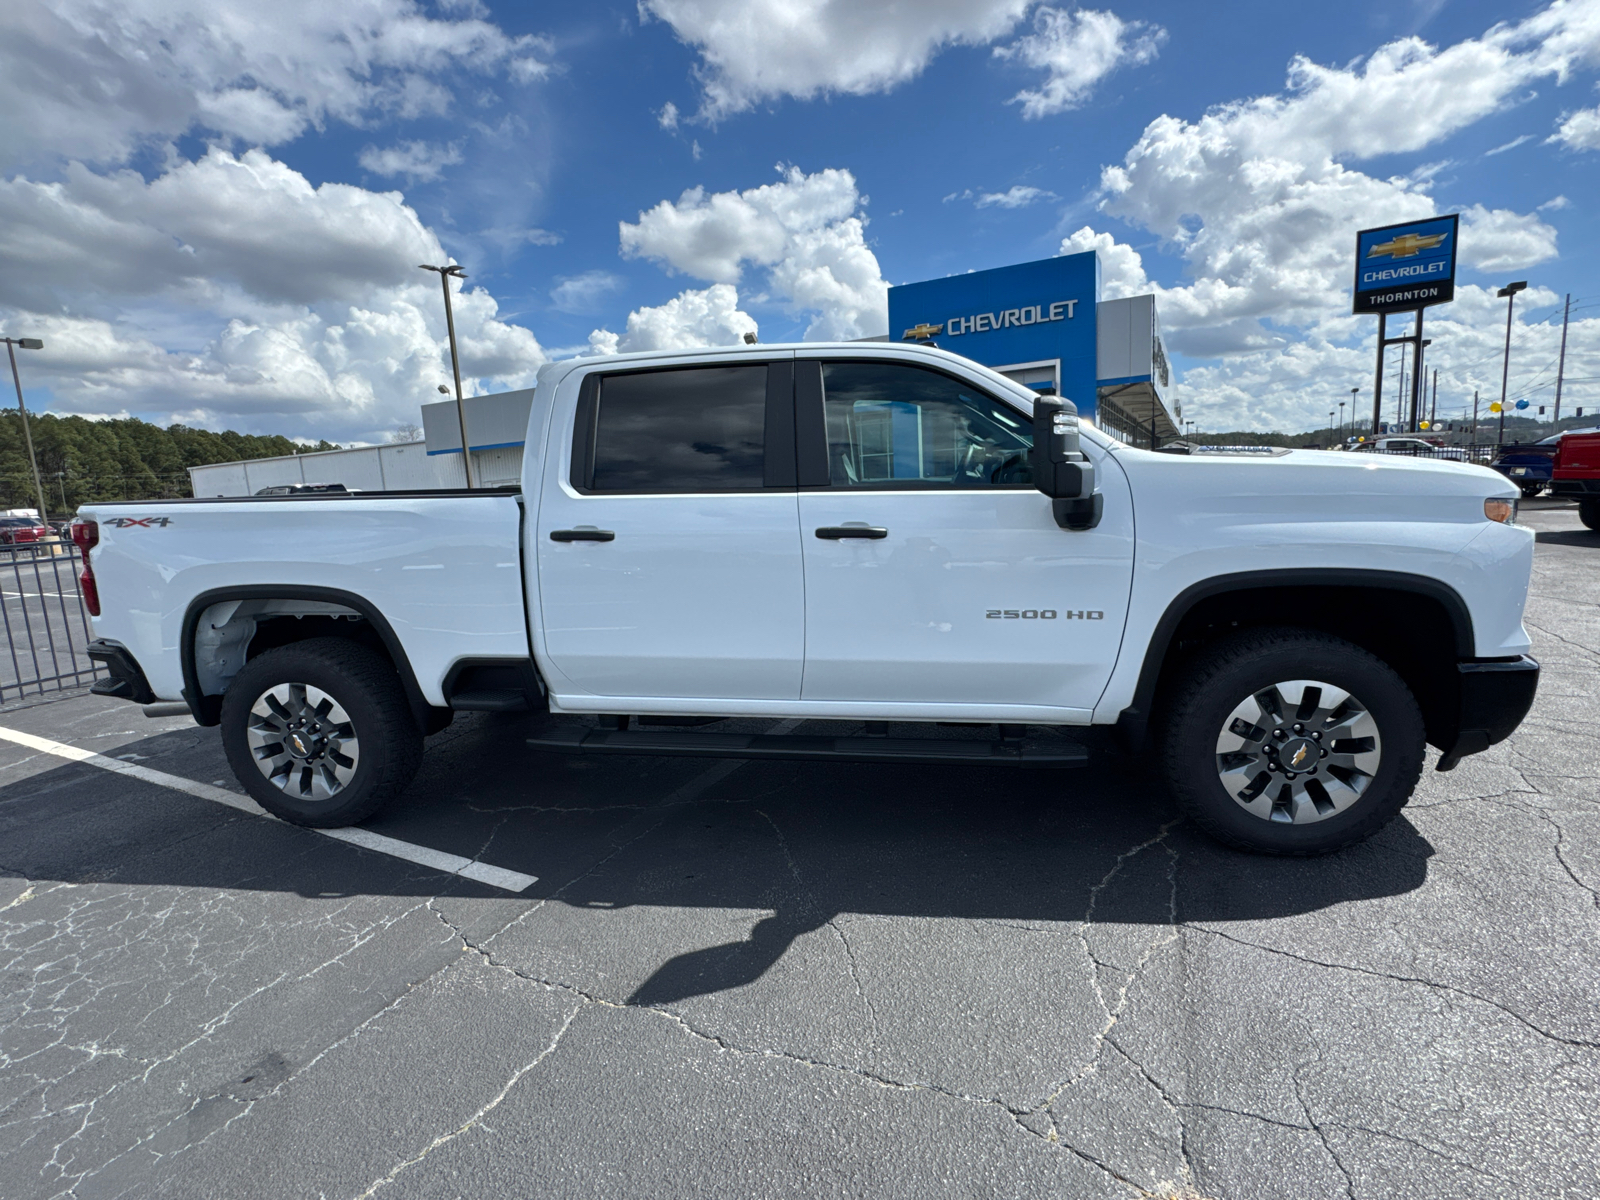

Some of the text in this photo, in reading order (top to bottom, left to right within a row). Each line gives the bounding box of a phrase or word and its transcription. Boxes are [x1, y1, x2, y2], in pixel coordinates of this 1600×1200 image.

[1363, 261, 1446, 282] CHEVROLET
[1369, 287, 1438, 305] THORNTON
[947, 299, 1078, 336] CHEVROLET
[985, 609, 1104, 620] 2500 HD
